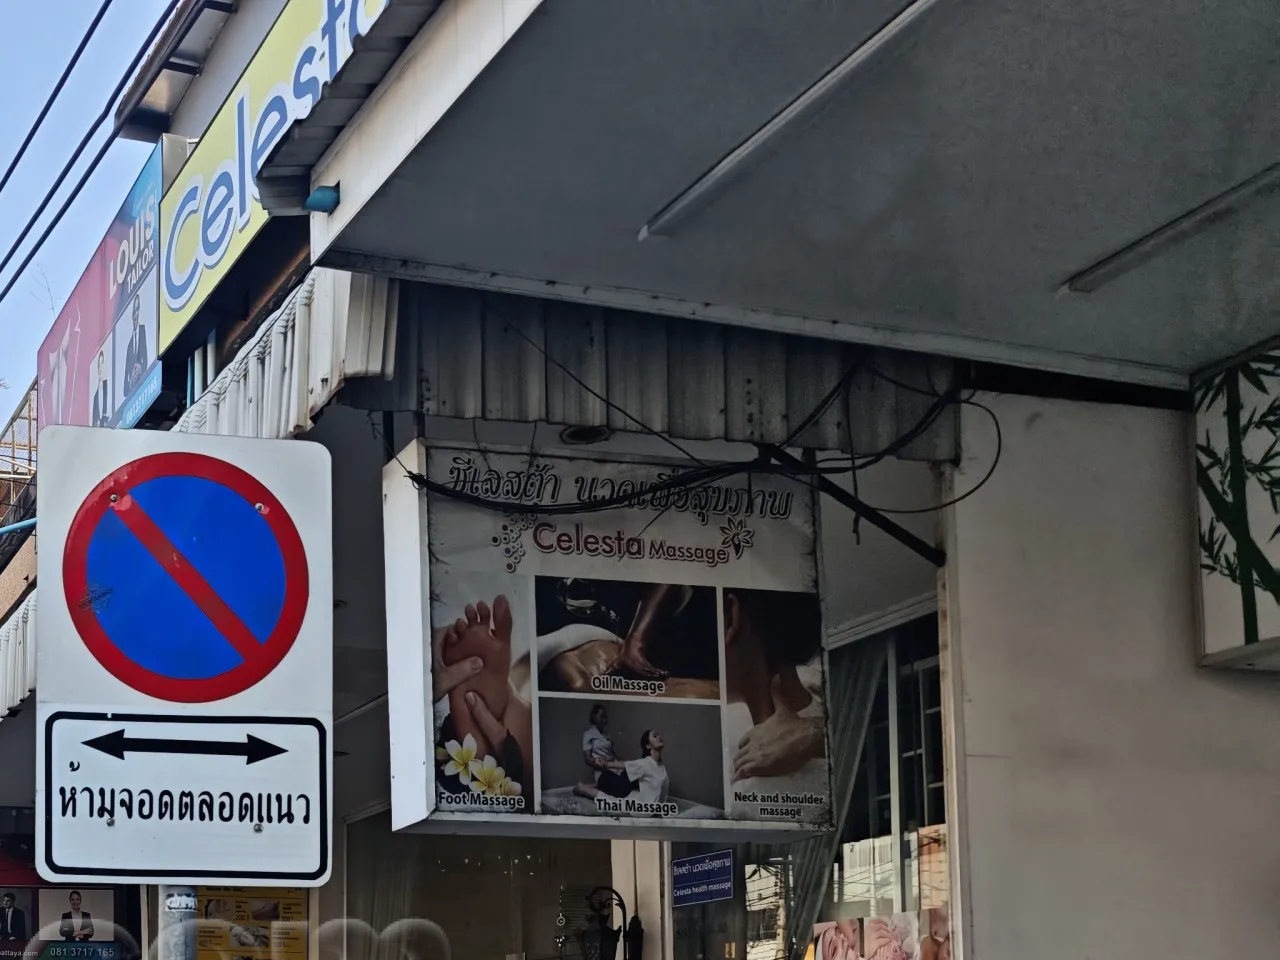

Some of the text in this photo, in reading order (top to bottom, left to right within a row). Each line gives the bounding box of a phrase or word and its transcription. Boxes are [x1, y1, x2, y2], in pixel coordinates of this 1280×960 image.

[109, 200, 156, 300] LOUIS
[127, 240, 155, 293] TAILOR
[532, 521, 730, 567] Celesta Massage
[592, 676, 665, 695] Oil Massage
[58, 761, 312, 826] ห้ามจอดตลอดแนว
[439, 791, 525, 809] Foot Massage
[734, 791, 824, 805] Neck and shoulder
[595, 798, 678, 816] Thai Massage
[760, 807, 802, 819] massage
[673, 881, 731, 897] Celesta health massage
[50, 947, 115, 957] 081 3717 165
